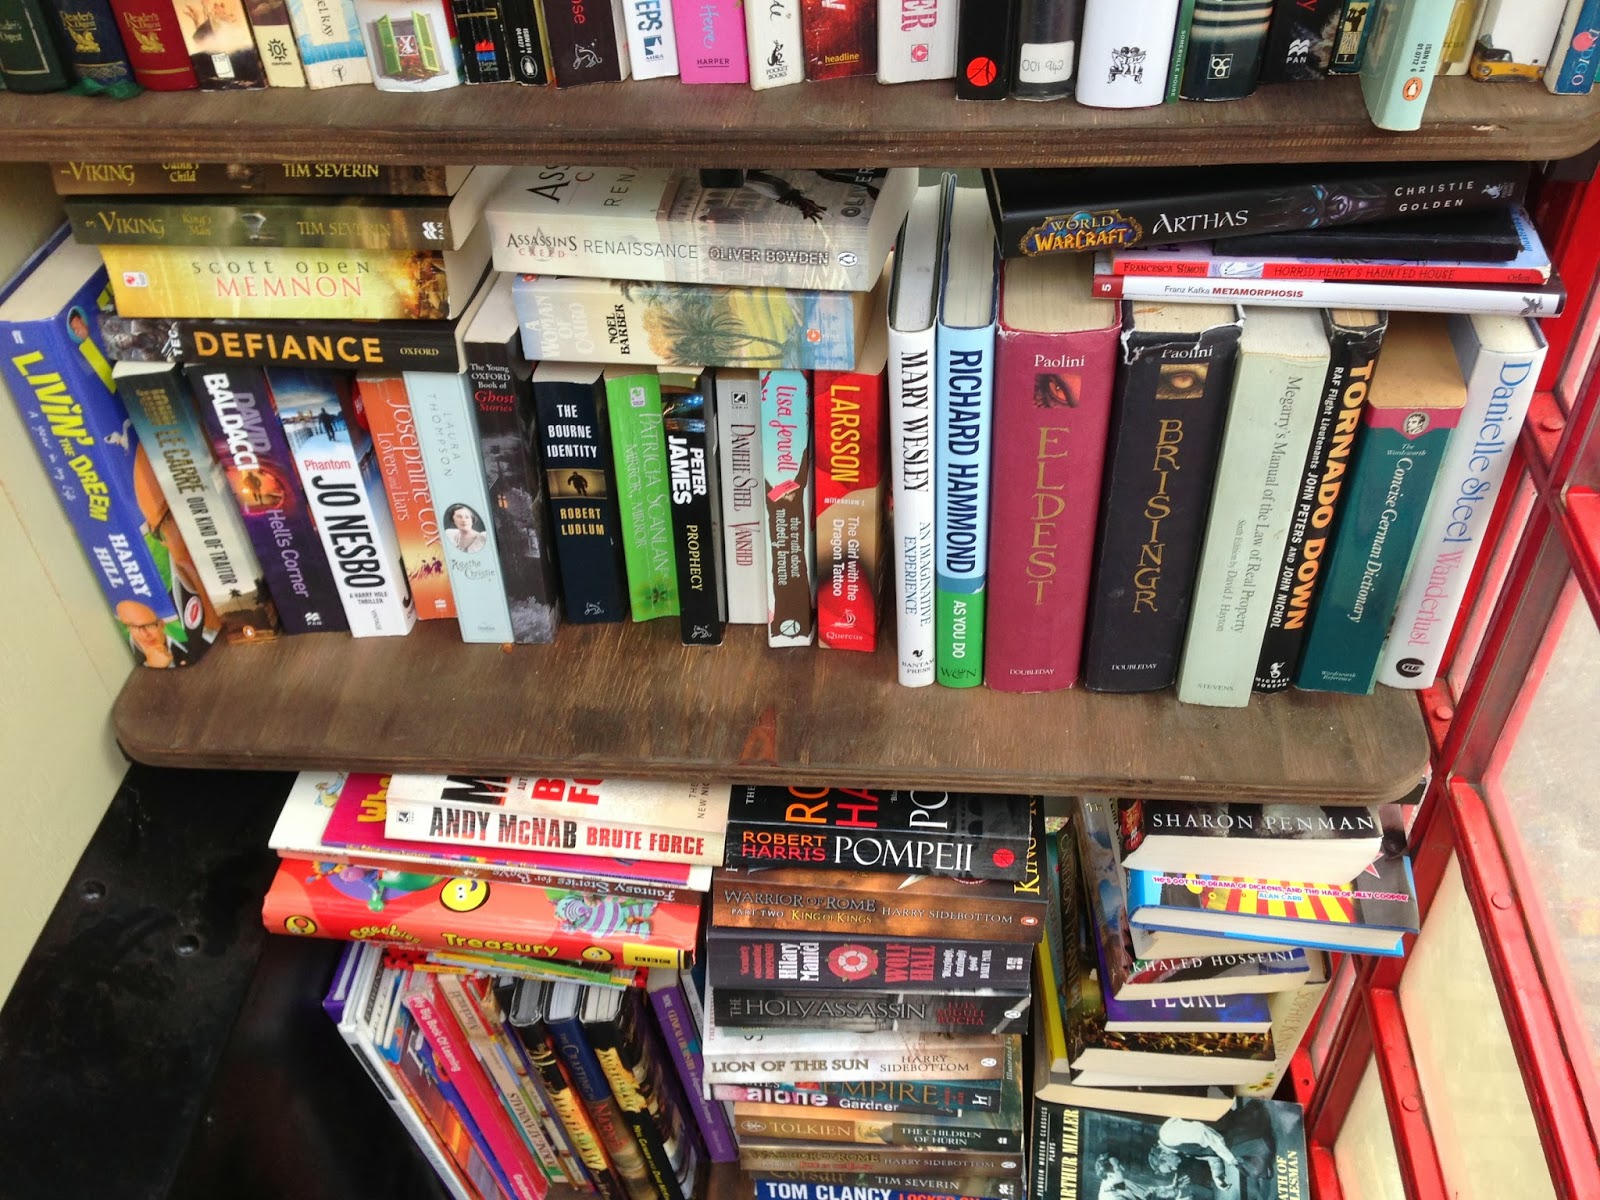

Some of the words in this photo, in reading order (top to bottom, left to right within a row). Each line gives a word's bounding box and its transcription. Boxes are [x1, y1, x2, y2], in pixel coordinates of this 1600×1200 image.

[700, 4, 720, 49] Here
[824, 52, 860, 63] headline
[1174, 30, 1186, 72] SOMERVILLE
[697, 57, 730, 65] HARPER
[766, 65, 789, 75] POCKET
[768, 72, 787, 80] BOOKS
[170, 171, 196, 183] Child
[314, 163, 379, 178] SEVERIN
[1395, 181, 1475, 197] CHRISTIE
[1399, 199, 1464, 212] GOLDEN
[98, 211, 165, 238] VIKING
[297, 221, 326, 236] TIM
[329, 222, 391, 237] SEVERIN
[1050, 214, 1115, 231] WORLD
[1152, 209, 1249, 235] ARTHAS
[1034, 228, 1132, 251] WARCRAFT
[583, 239, 698, 259] RENAISSANCE
[709, 247, 761, 262] OLIVER
[765, 249, 830, 266] BOWDEN
[1123, 262, 1173, 273] FRANCESCA
[1176, 260, 1205, 274] SIMON
[1274, 266, 1315, 277] HORRID
[1318, 267, 1362, 278] HENRY'S
[1365, 267, 1417, 278] HAUNTED
[1419, 268, 1455, 279] HOUSE
[216, 277, 362, 297] MEMNON
[1165, 285, 1186, 294] Franz
[1188, 285, 1210, 294] Kafka
[1212, 286, 1304, 298] METAMORPHOSIS
[608, 312, 619, 345] NOEL
[619, 303, 631, 356] BARBER
[194, 331, 384, 363] DEFIANCE
[400, 346, 439, 356] OXFORD
[470, 363, 484, 372] The
[486, 364, 509, 373] Young
[1033, 354, 1086, 369] Paolini
[471, 372, 511, 382] OXFORD
[478, 381, 498, 389] Book
[499, 381, 507, 389] of
[901, 349, 928, 409] MARY
[1332, 366, 1344, 386] RAF
[474, 391, 515, 404] Ghost
[948, 349, 983, 456] RICHARD
[1324, 388, 1338, 415] Flight
[479, 402, 513, 412] Stories
[556, 404, 578, 418] THE
[1468, 359, 1533, 472] Danielle
[203, 373, 259, 471] BALDACCI
[427, 393, 452, 477] THOMPSON
[548, 424, 592, 439] BOURNE
[830, 384, 861, 483] LARSSON
[387, 399, 431, 505] Josephine
[547, 444, 597, 458] IDENTITY
[639, 412, 662, 488] PATRICIA
[1310, 417, 1331, 470] Lieutenants
[903, 414, 929, 493] WESLEY
[303, 459, 351, 471] Phantom
[668, 435, 692, 505] JAMES
[689, 447, 707, 496] PETER
[311, 476, 361, 507] JO
[560, 507, 601, 520] ROBERT
[1025, 426, 1070, 607] ELDEST
[1132, 418, 1184, 614] BRISINGR
[1443, 474, 1491, 545] Steel
[849, 516, 860, 536] The
[946, 463, 979, 575] HAMMOND
[561, 524, 605, 536] LUDLUM
[833, 519, 844, 561] Dragon
[848, 539, 860, 559] Girl
[324, 514, 386, 588] NESBO
[686, 524, 703, 592] PROPHECY
[1287, 545, 1298, 564] AND
[108, 533, 152, 599] HARRY
[280, 549, 309, 598] Corner
[777, 549, 787, 586] browne
[848, 561, 860, 581] with
[832, 562, 843, 597] Tattoo
[903, 536, 917, 615] EXPERIENCE
[919, 538, 933, 627] IMAGINATIVE
[1284, 537, 1326, 630] DOWN
[847, 582, 857, 601] the
[1407, 547, 1460, 647] Wanderlust
[953, 599, 967, 614] AS
[1270, 593, 1287, 629] NICHOL
[825, 631, 863, 641] Quercus
[952, 616, 966, 639] YOU
[952, 641, 966, 659] DO
[901, 659, 935, 669] BANTAM
[907, 666, 931, 675] PRESS
[940, 666, 977, 680] W&N
[1009, 668, 1055, 676] DOUBLEDAY
[1111, 663, 1158, 672] DOUBLEDAY
[1321, 670, 1357, 678] Wordsworth
[1197, 683, 1234, 692] STEVENS
[689, 782, 699, 799] THE
[697, 798, 706, 819] NEW
[1152, 813, 1253, 829] SHARON
[1265, 815, 1375, 830] PENMAN
[429, 806, 490, 841] ANDY
[586, 826, 642, 850] BRUTE
[650, 833, 704, 856] FORCE
[742, 831, 827, 848] ROBERT
[741, 844, 826, 862] HARRIS
[834, 836, 973, 872] POMPEII
[724, 889, 803, 906] WARRIOR
[807, 895, 824, 906] OF
[1258, 892, 1279, 900] ALAN
[731, 907, 758, 917] PART
[761, 909, 784, 918] TWO
[791, 910, 821, 922] KING
[836, 912, 873, 924] KINGS
[882, 906, 925, 918] HARRY
[928, 909, 1014, 924] SIDEBOTTOM
[441, 931, 559, 958] Treasury
[729, 996, 742, 1017] THE
[937, 1016, 984, 1025] ROCHA
[711, 1061, 755, 1073] LION
[760, 1060, 786, 1072] OF
[794, 1059, 828, 1072] THE
[831, 1058, 869, 1071] SUN
[880, 1063, 970, 1072] SIDEBOTTOM
[901, 1054, 948, 1063] HARRY
[839, 1100, 898, 1112] Gardner
[769, 1121, 850, 1136] TOLKIEN
[1040, 1106, 1048, 1138] CLASSICS
[1062, 1108, 1079, 1154] MILLER
[901, 1127, 925, 1136] THE
[927, 1129, 982, 1139] CHILDREN
[914, 1136, 930, 1144] OF
[884, 1158, 920, 1166] HARRY
[923, 1159, 995, 1168] SIDEBOTTOM
[875, 1176, 901, 1186] TIM
[905, 1178, 960, 1190] SEVERIN
